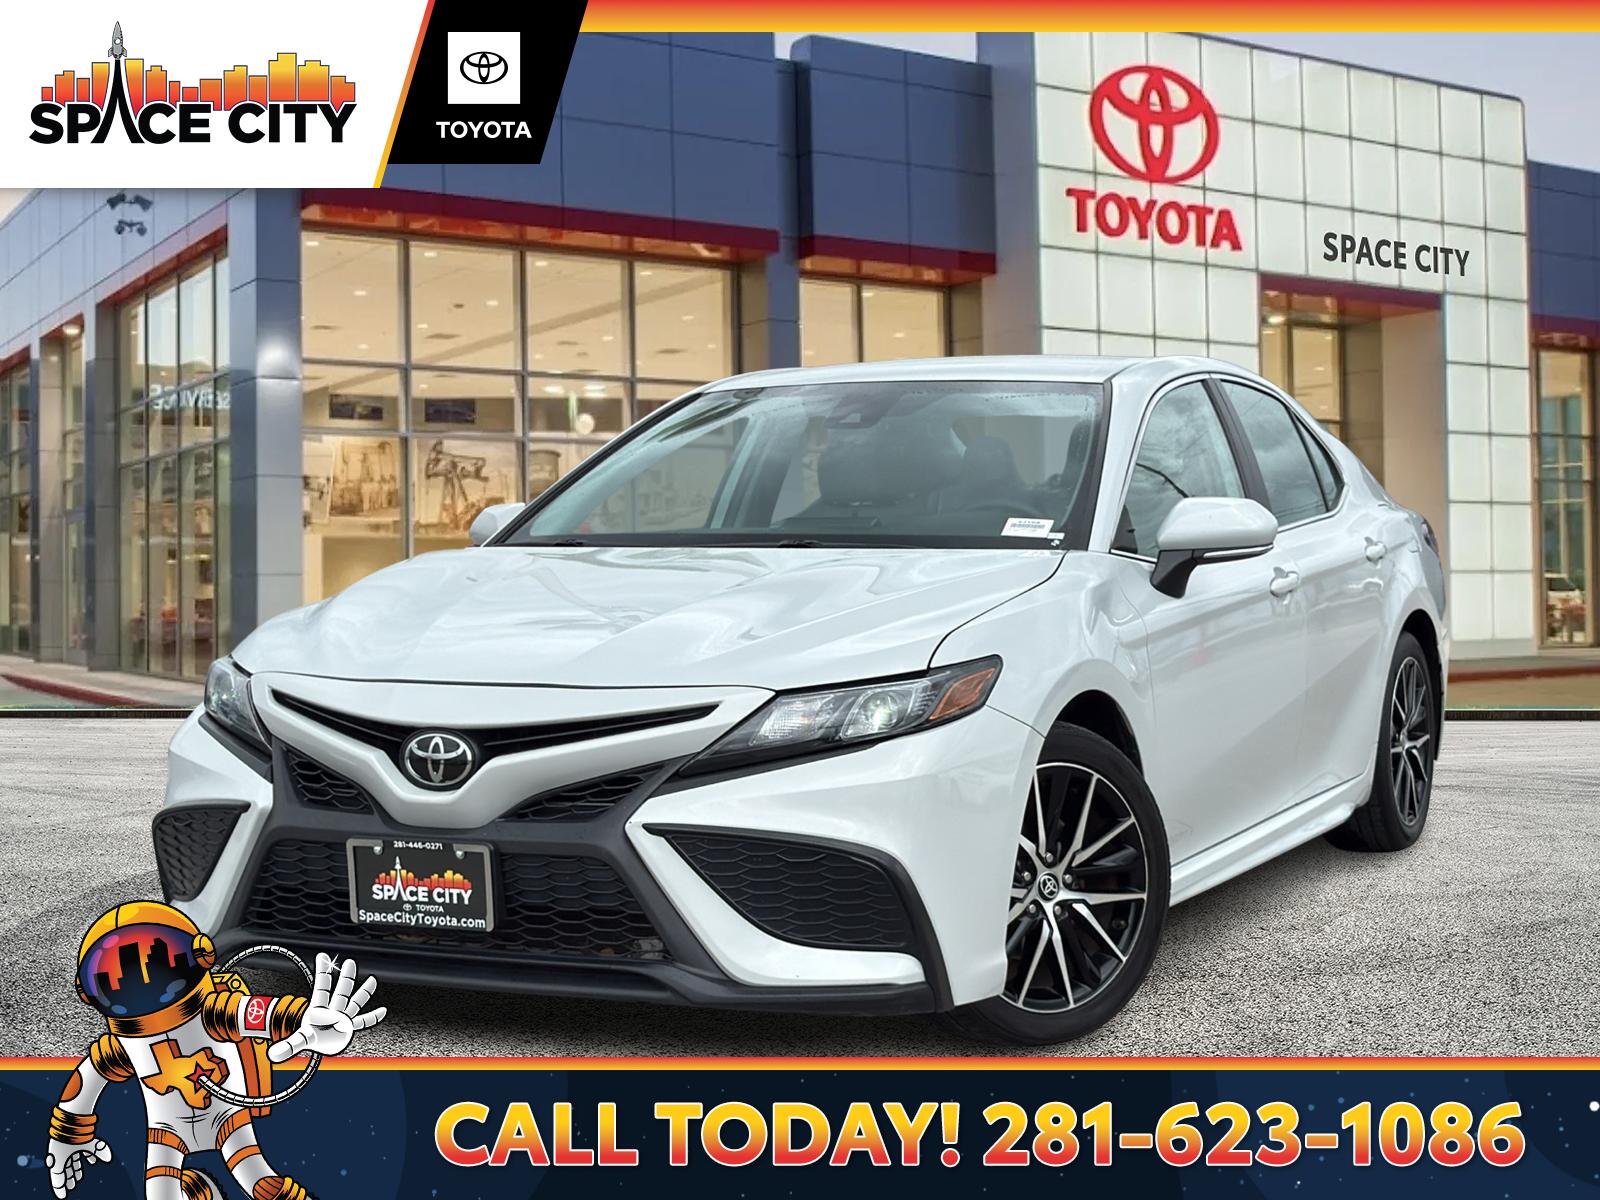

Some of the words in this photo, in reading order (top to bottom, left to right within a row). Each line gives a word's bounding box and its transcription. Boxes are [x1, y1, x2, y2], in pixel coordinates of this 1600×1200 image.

[1066, 188, 1242, 251] TOYOTA
[1323, 232, 1407, 270] SPACE
[1415, 245, 1470, 276] CITY
[372, 873, 428, 902] SPACE
[432, 888, 473, 905] CITY
[359, 909, 486, 928] SpaceCityToyota.com
[416, 904, 444, 912] TOYOTA
